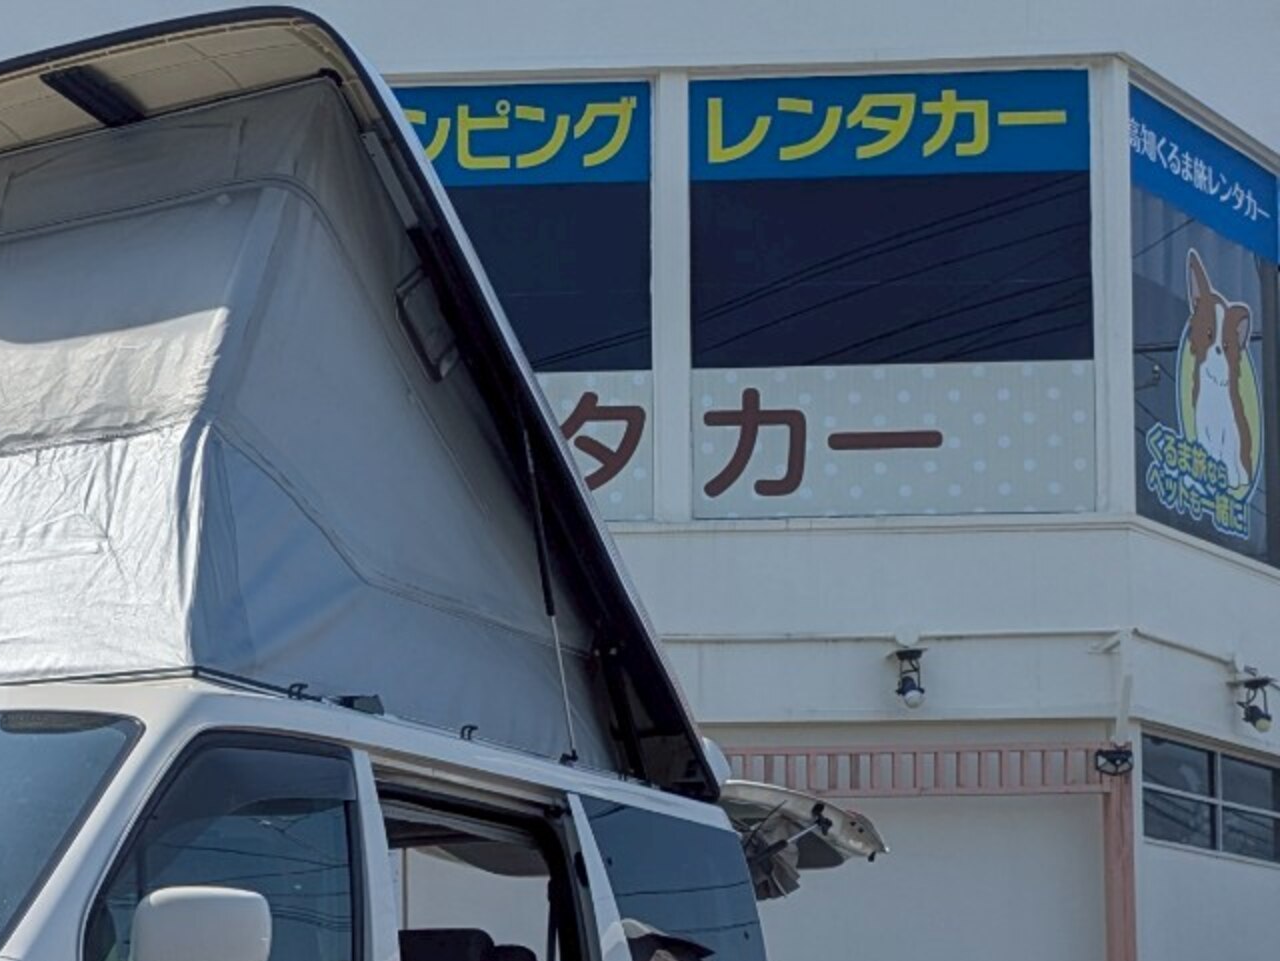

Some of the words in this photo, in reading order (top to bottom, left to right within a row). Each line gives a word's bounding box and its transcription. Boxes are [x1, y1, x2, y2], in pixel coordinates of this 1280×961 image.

[404, 96, 637, 168] ンピング
[708, 90, 1066, 163] レンタカー
